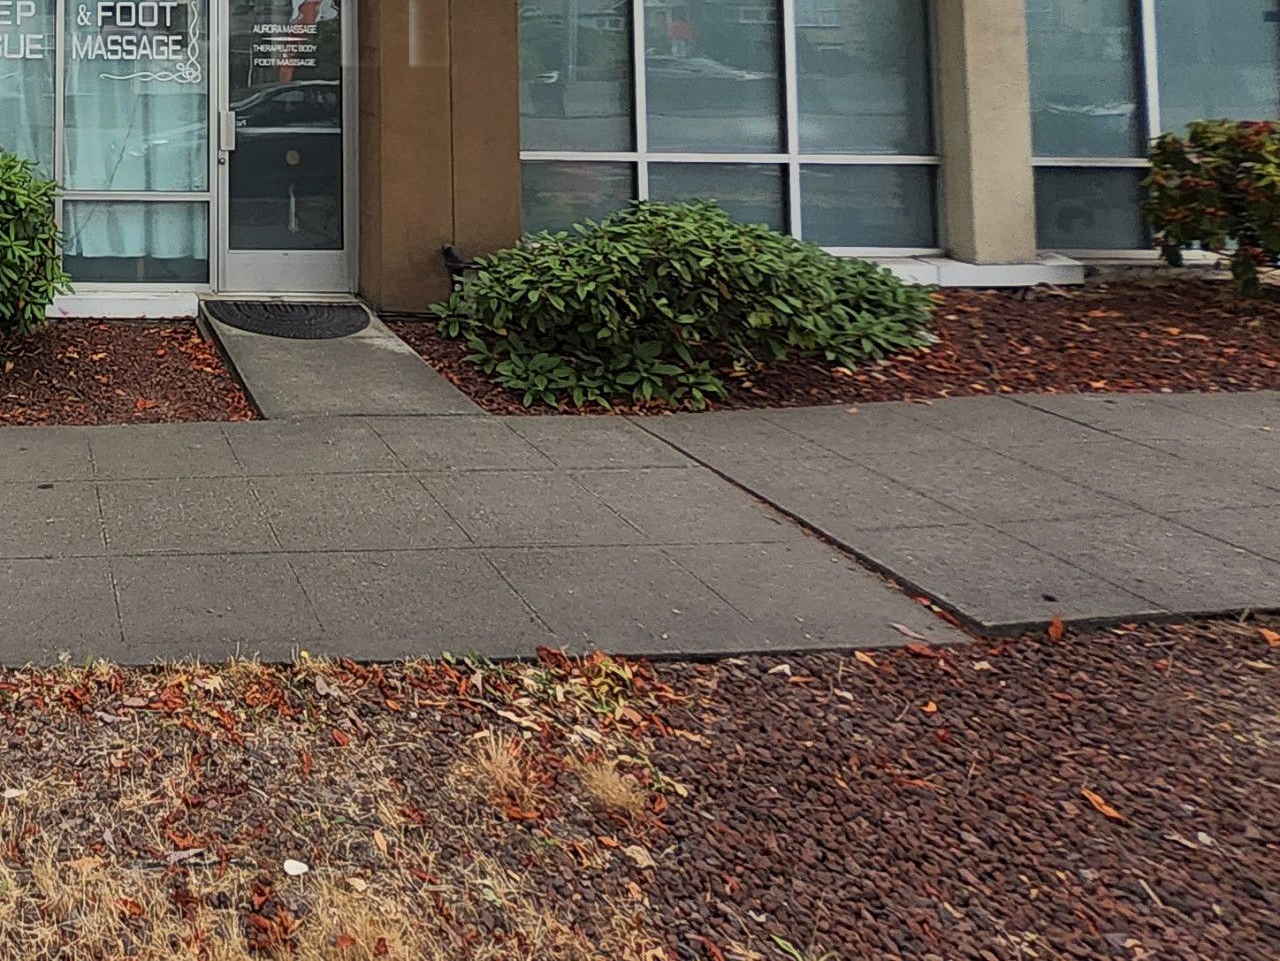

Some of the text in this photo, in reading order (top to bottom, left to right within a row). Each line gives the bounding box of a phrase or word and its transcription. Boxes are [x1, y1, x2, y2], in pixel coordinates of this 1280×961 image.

[76, 1, 178, 27] & FOOT
[252, 24, 318, 34] AURORA MASSAGE
[71, 34, 183, 59] MASSAGE
[252, 44, 317, 52] THERAPEUTIC BODY
[253, 58, 317, 67] FOOT MASSAGE
